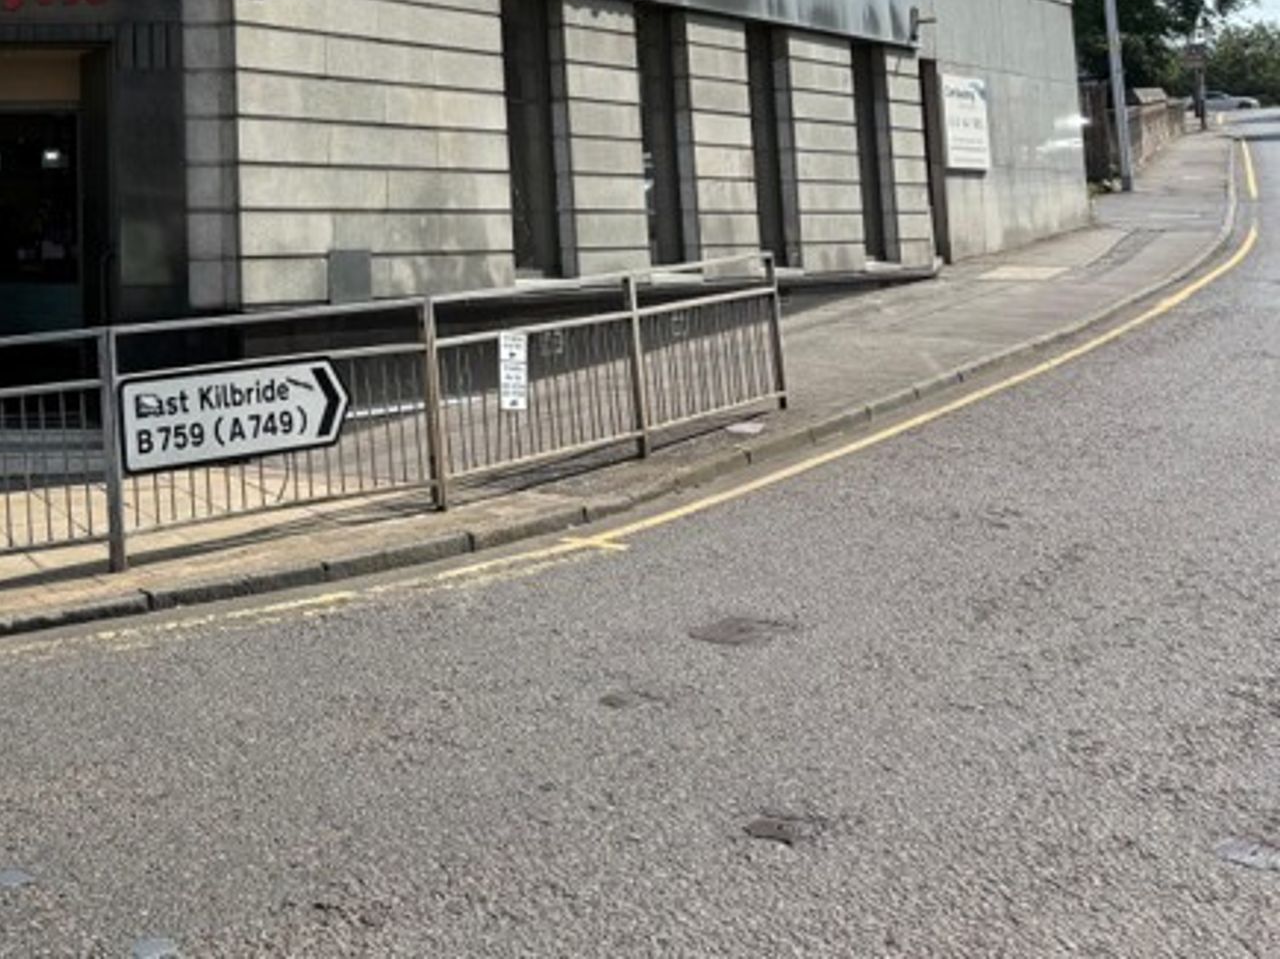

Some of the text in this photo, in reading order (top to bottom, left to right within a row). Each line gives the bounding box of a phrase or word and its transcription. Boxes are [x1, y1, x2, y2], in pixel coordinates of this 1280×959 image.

[134, 378, 290, 419] East Kilbride
[136, 404, 308, 455] B759 (A749)
